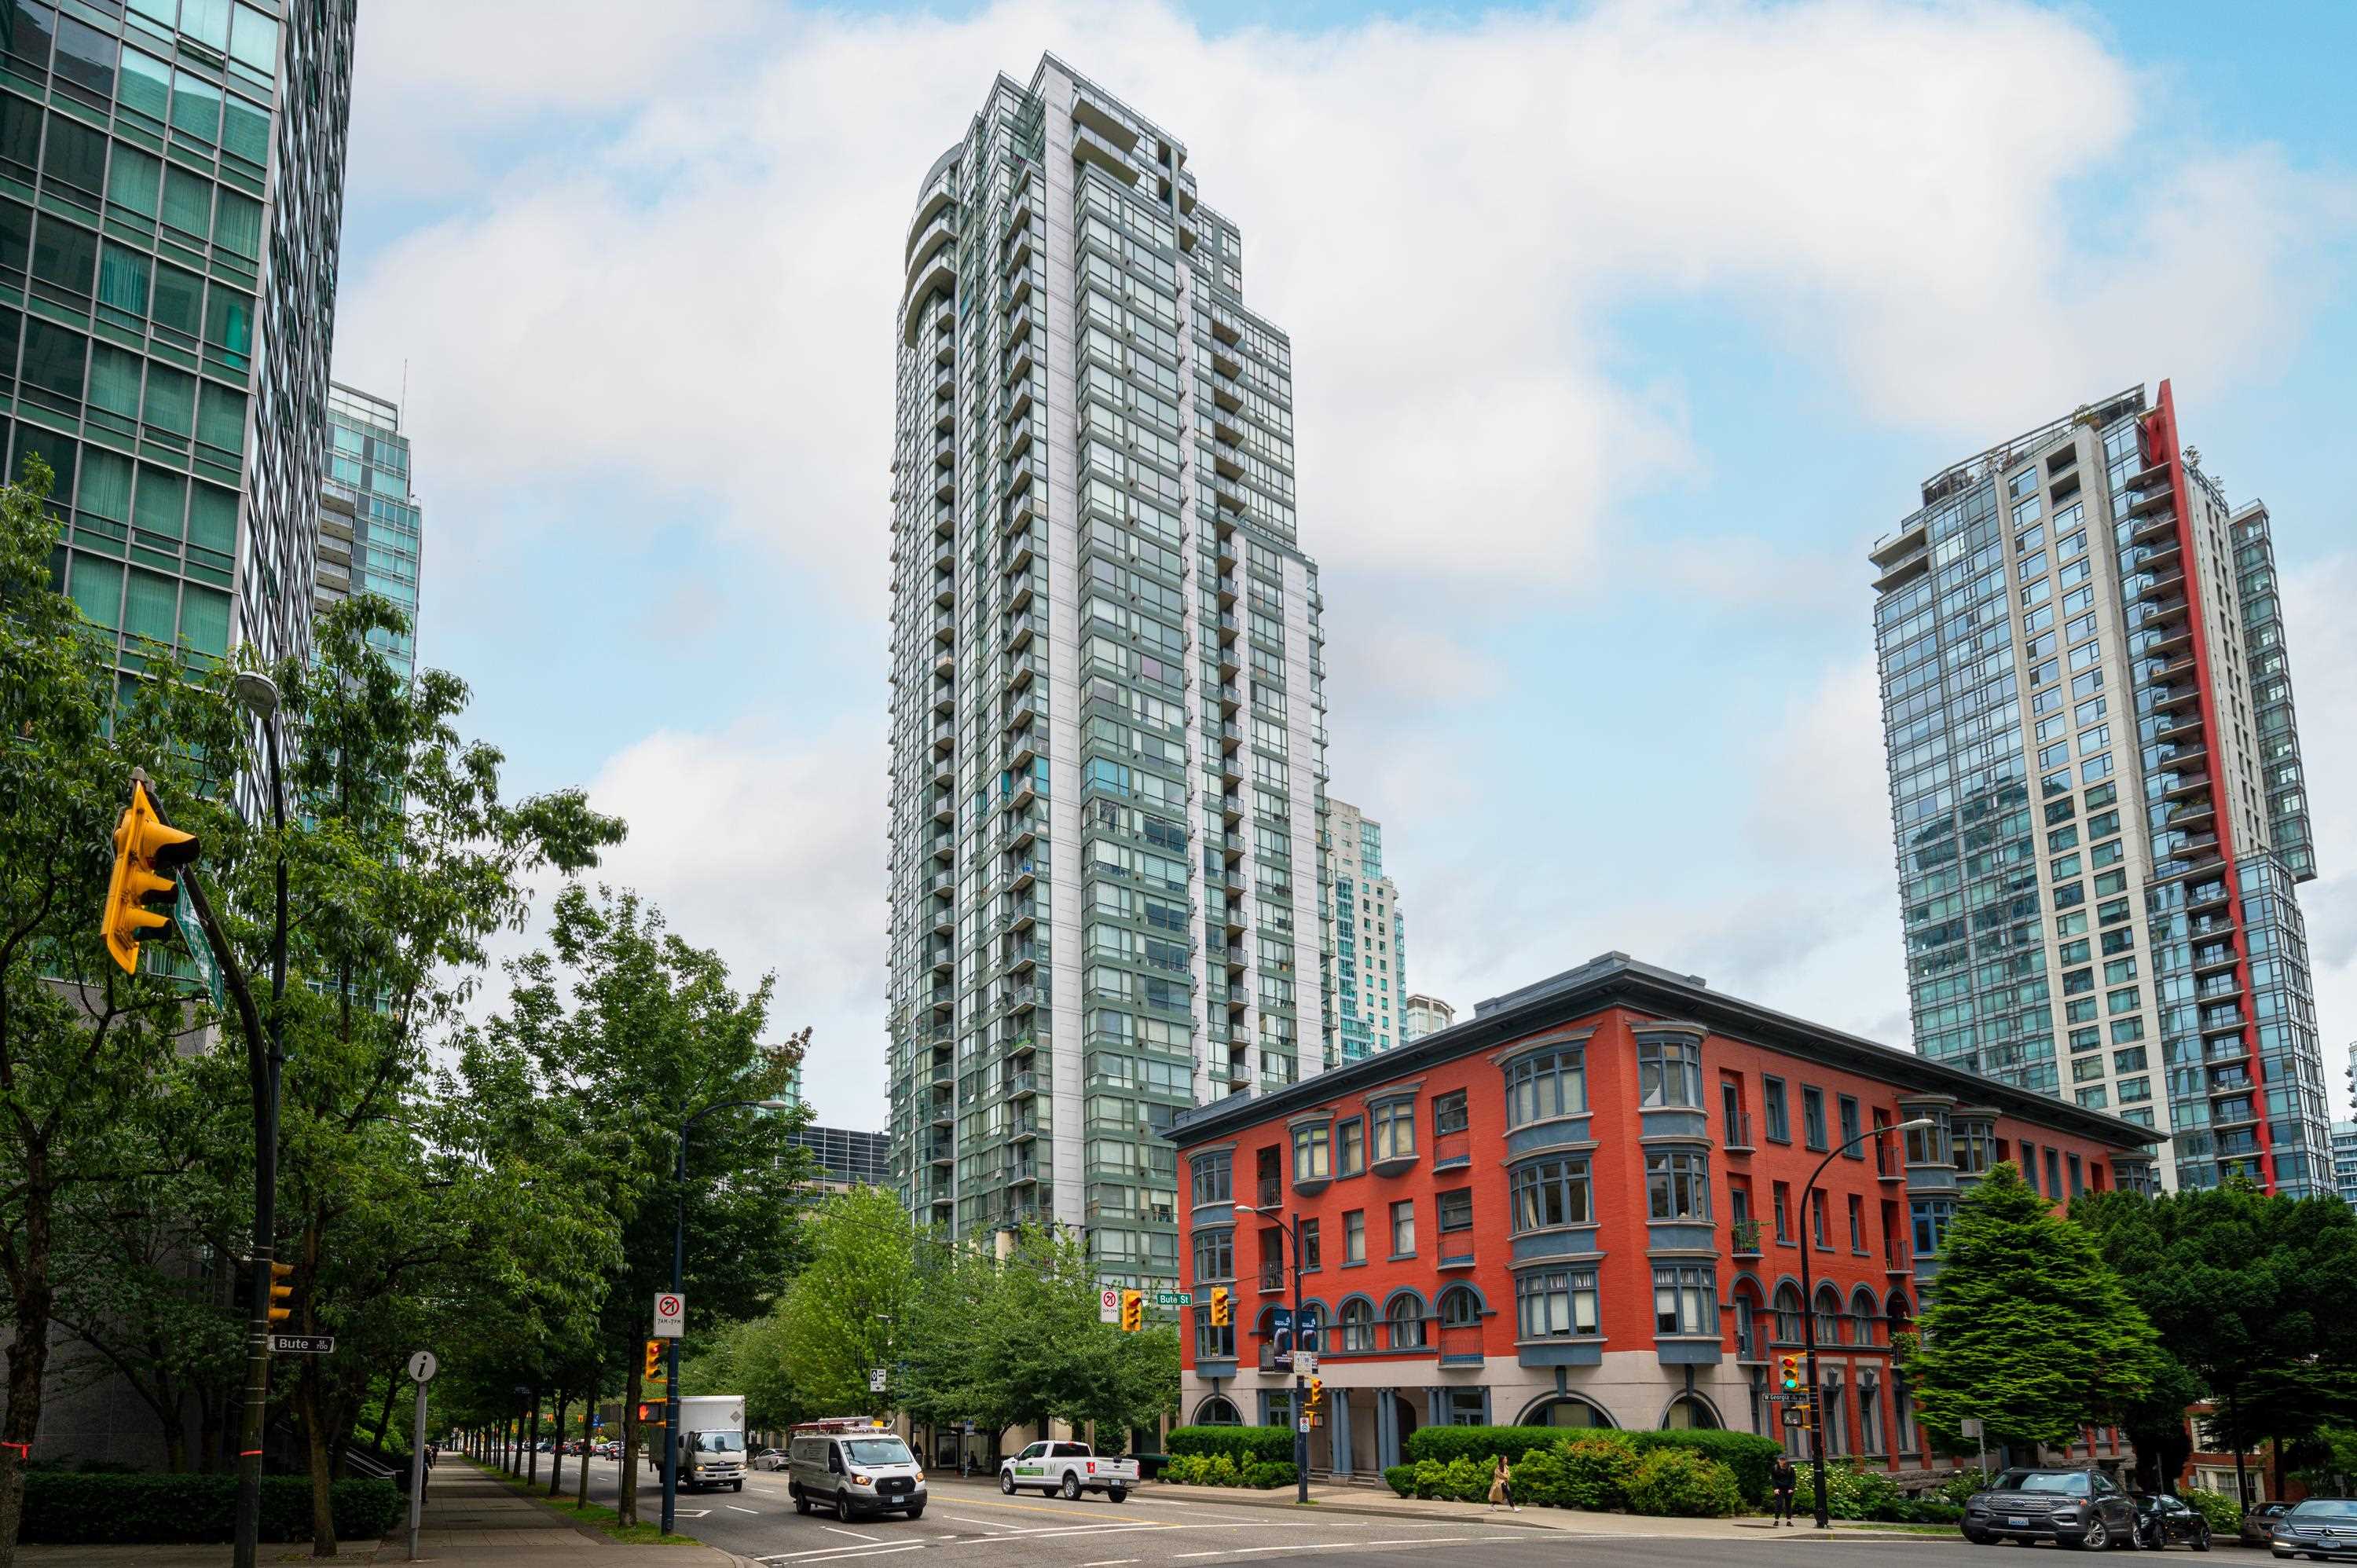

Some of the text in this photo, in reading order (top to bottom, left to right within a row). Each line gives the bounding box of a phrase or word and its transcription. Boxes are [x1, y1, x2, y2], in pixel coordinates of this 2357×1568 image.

[1160, 1295, 1189, 1303] Bute St
[279, 1339, 309, 1349] Bute
